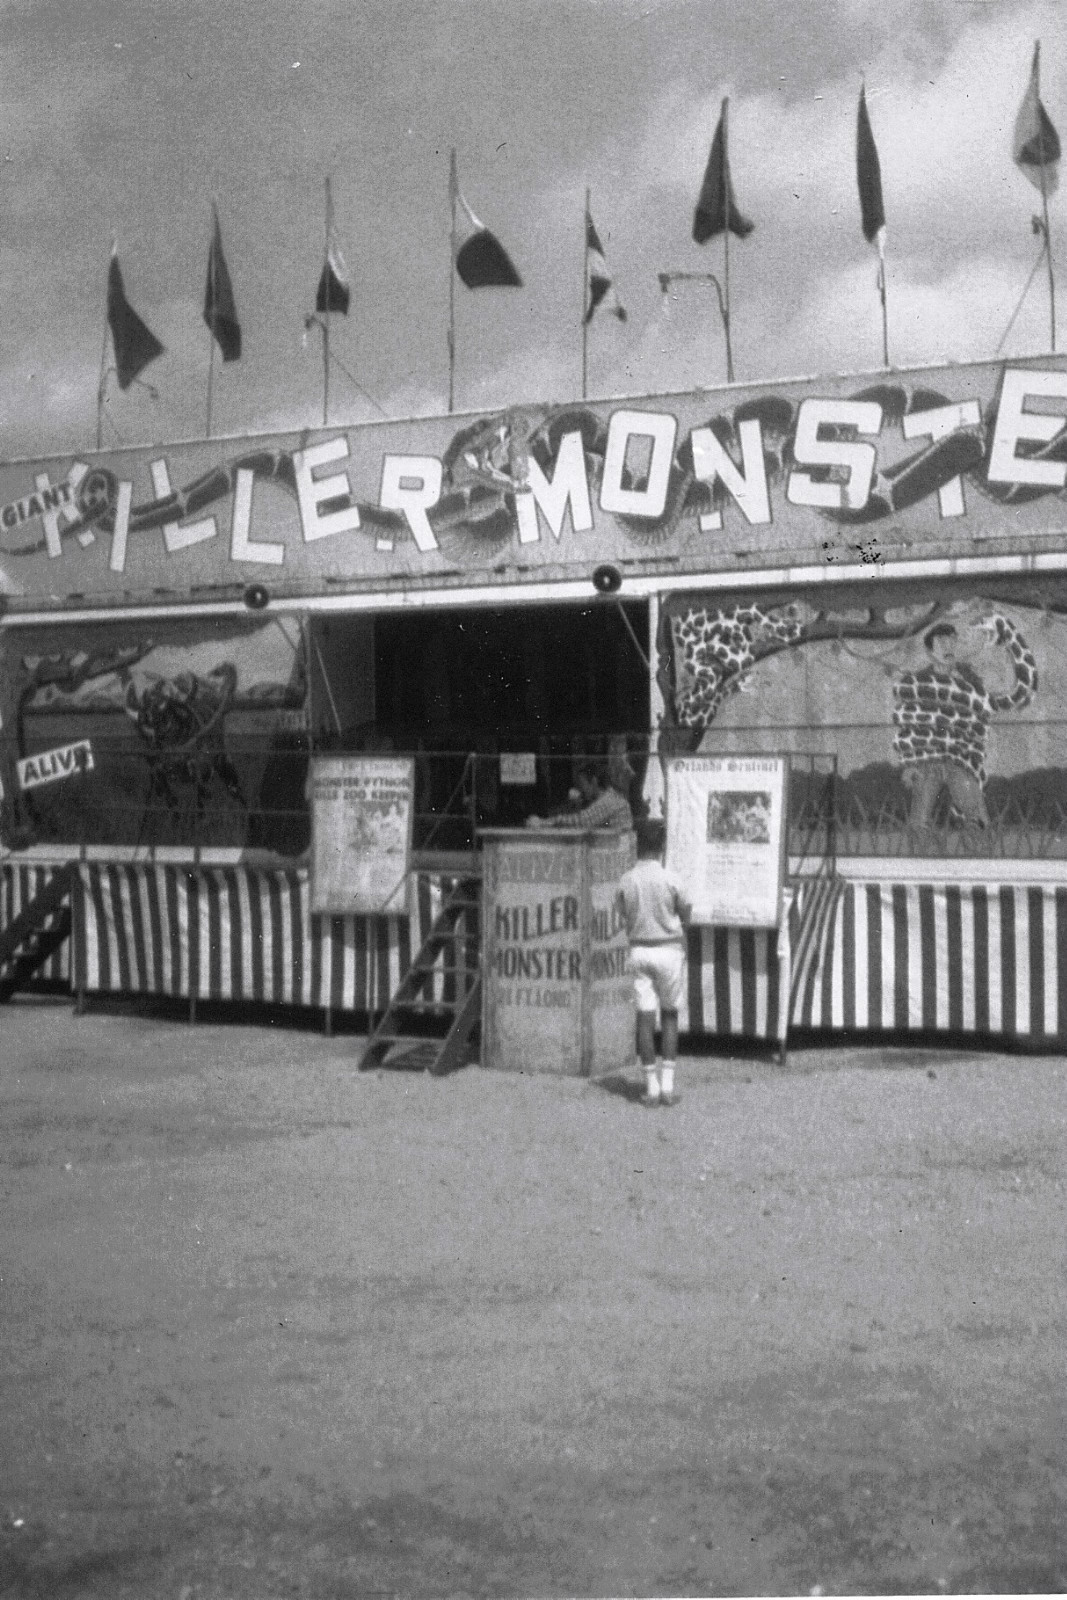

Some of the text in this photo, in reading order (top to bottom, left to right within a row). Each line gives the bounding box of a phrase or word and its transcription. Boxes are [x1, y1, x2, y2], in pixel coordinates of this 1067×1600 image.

[3, 481, 70, 528] GIANT
[34, 436, 442, 572] KILLER
[343, 789, 366, 800] ZOO
[496, 895, 578, 941] KILLER
